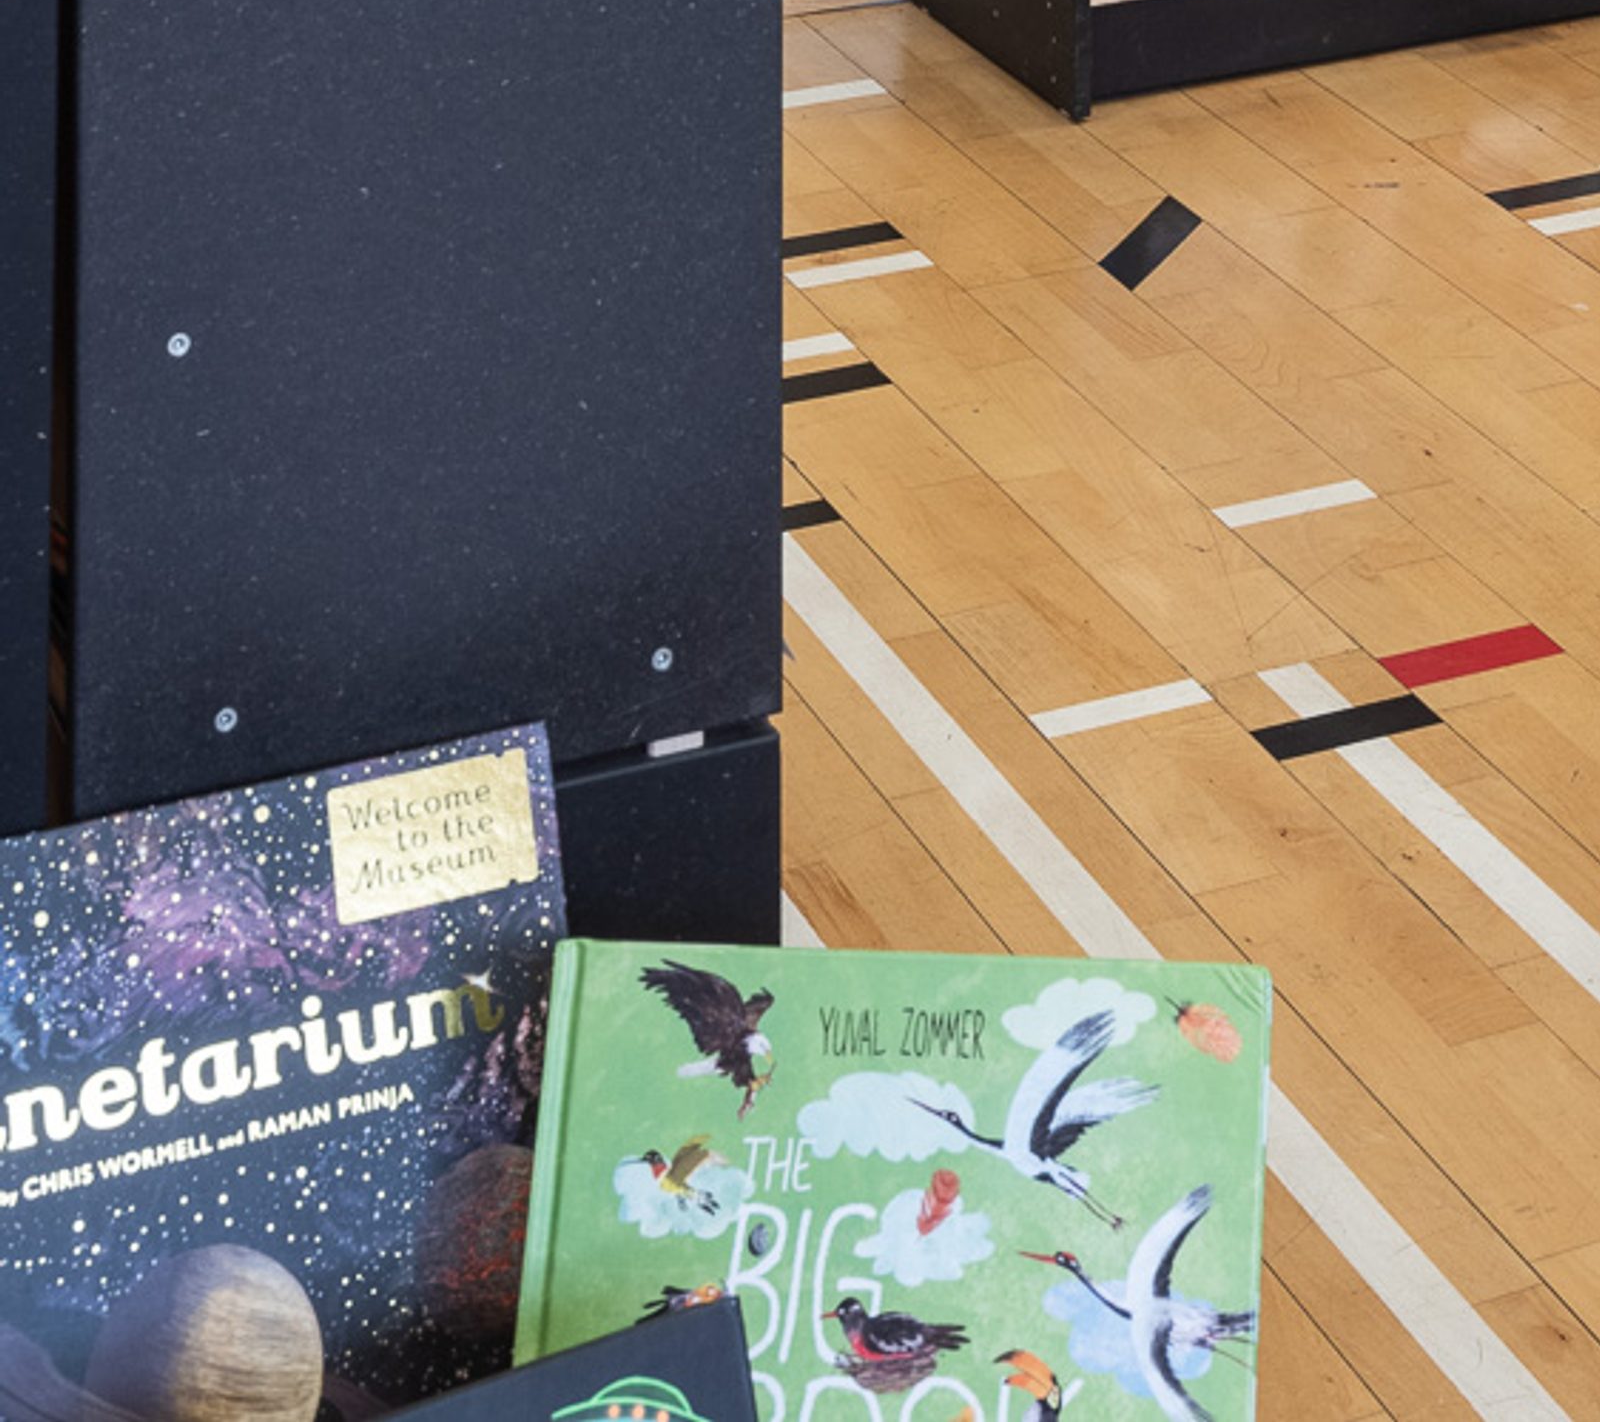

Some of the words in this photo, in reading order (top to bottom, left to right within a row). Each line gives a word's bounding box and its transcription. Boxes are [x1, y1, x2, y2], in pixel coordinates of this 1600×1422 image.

[342, 780, 493, 833] Welcome
[397, 827, 428, 854] to
[445, 814, 495, 843] the
[350, 844, 498, 893] Museum
[819, 1006, 887, 1057] YUVAL
[900, 1007, 986, 1060] ZOMMER
[0, 982, 506, 1152] netarium
[22, 1160, 94, 1201] CHRIS
[98, 1136, 214, 1182] WORMELL
[217, 1129, 244, 1151] and
[247, 1103, 333, 1144] RAMAN
[338, 1083, 414, 1120] PRINJA
[741, 1135, 815, 1193] THE
[725, 1201, 884, 1364] BIG
